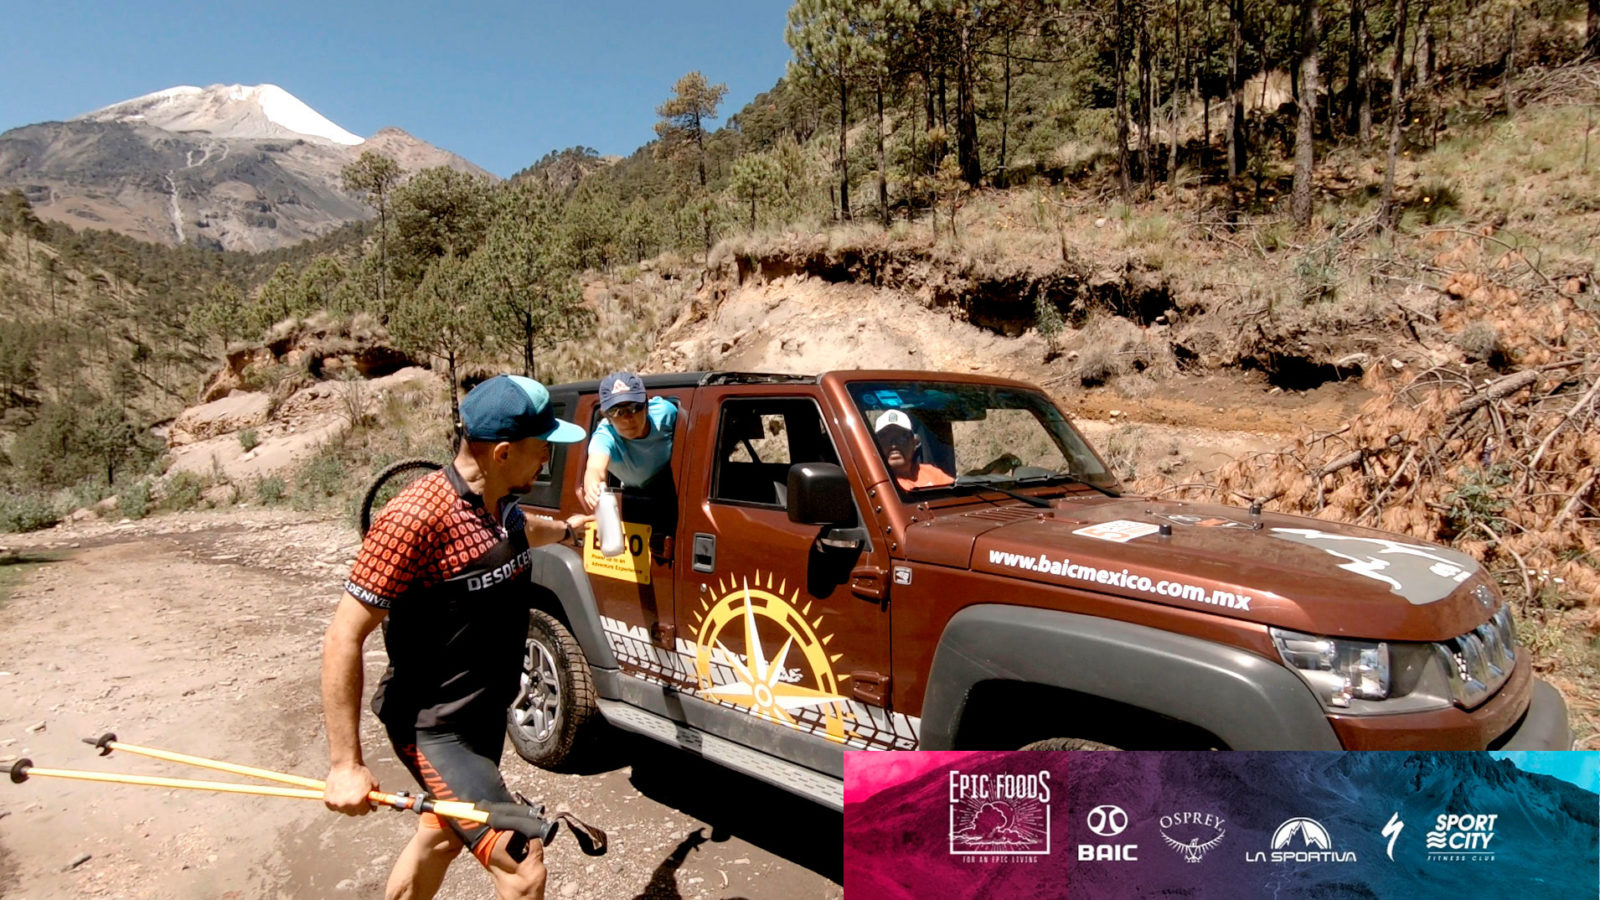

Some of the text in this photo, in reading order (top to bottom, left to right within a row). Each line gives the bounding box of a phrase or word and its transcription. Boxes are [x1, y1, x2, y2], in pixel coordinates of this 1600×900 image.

[467, 561, 516, 592] DESDE
[989, 549, 1252, 611] www.baicmexico.com.mx
[360, 589, 391, 608] NIVEL
